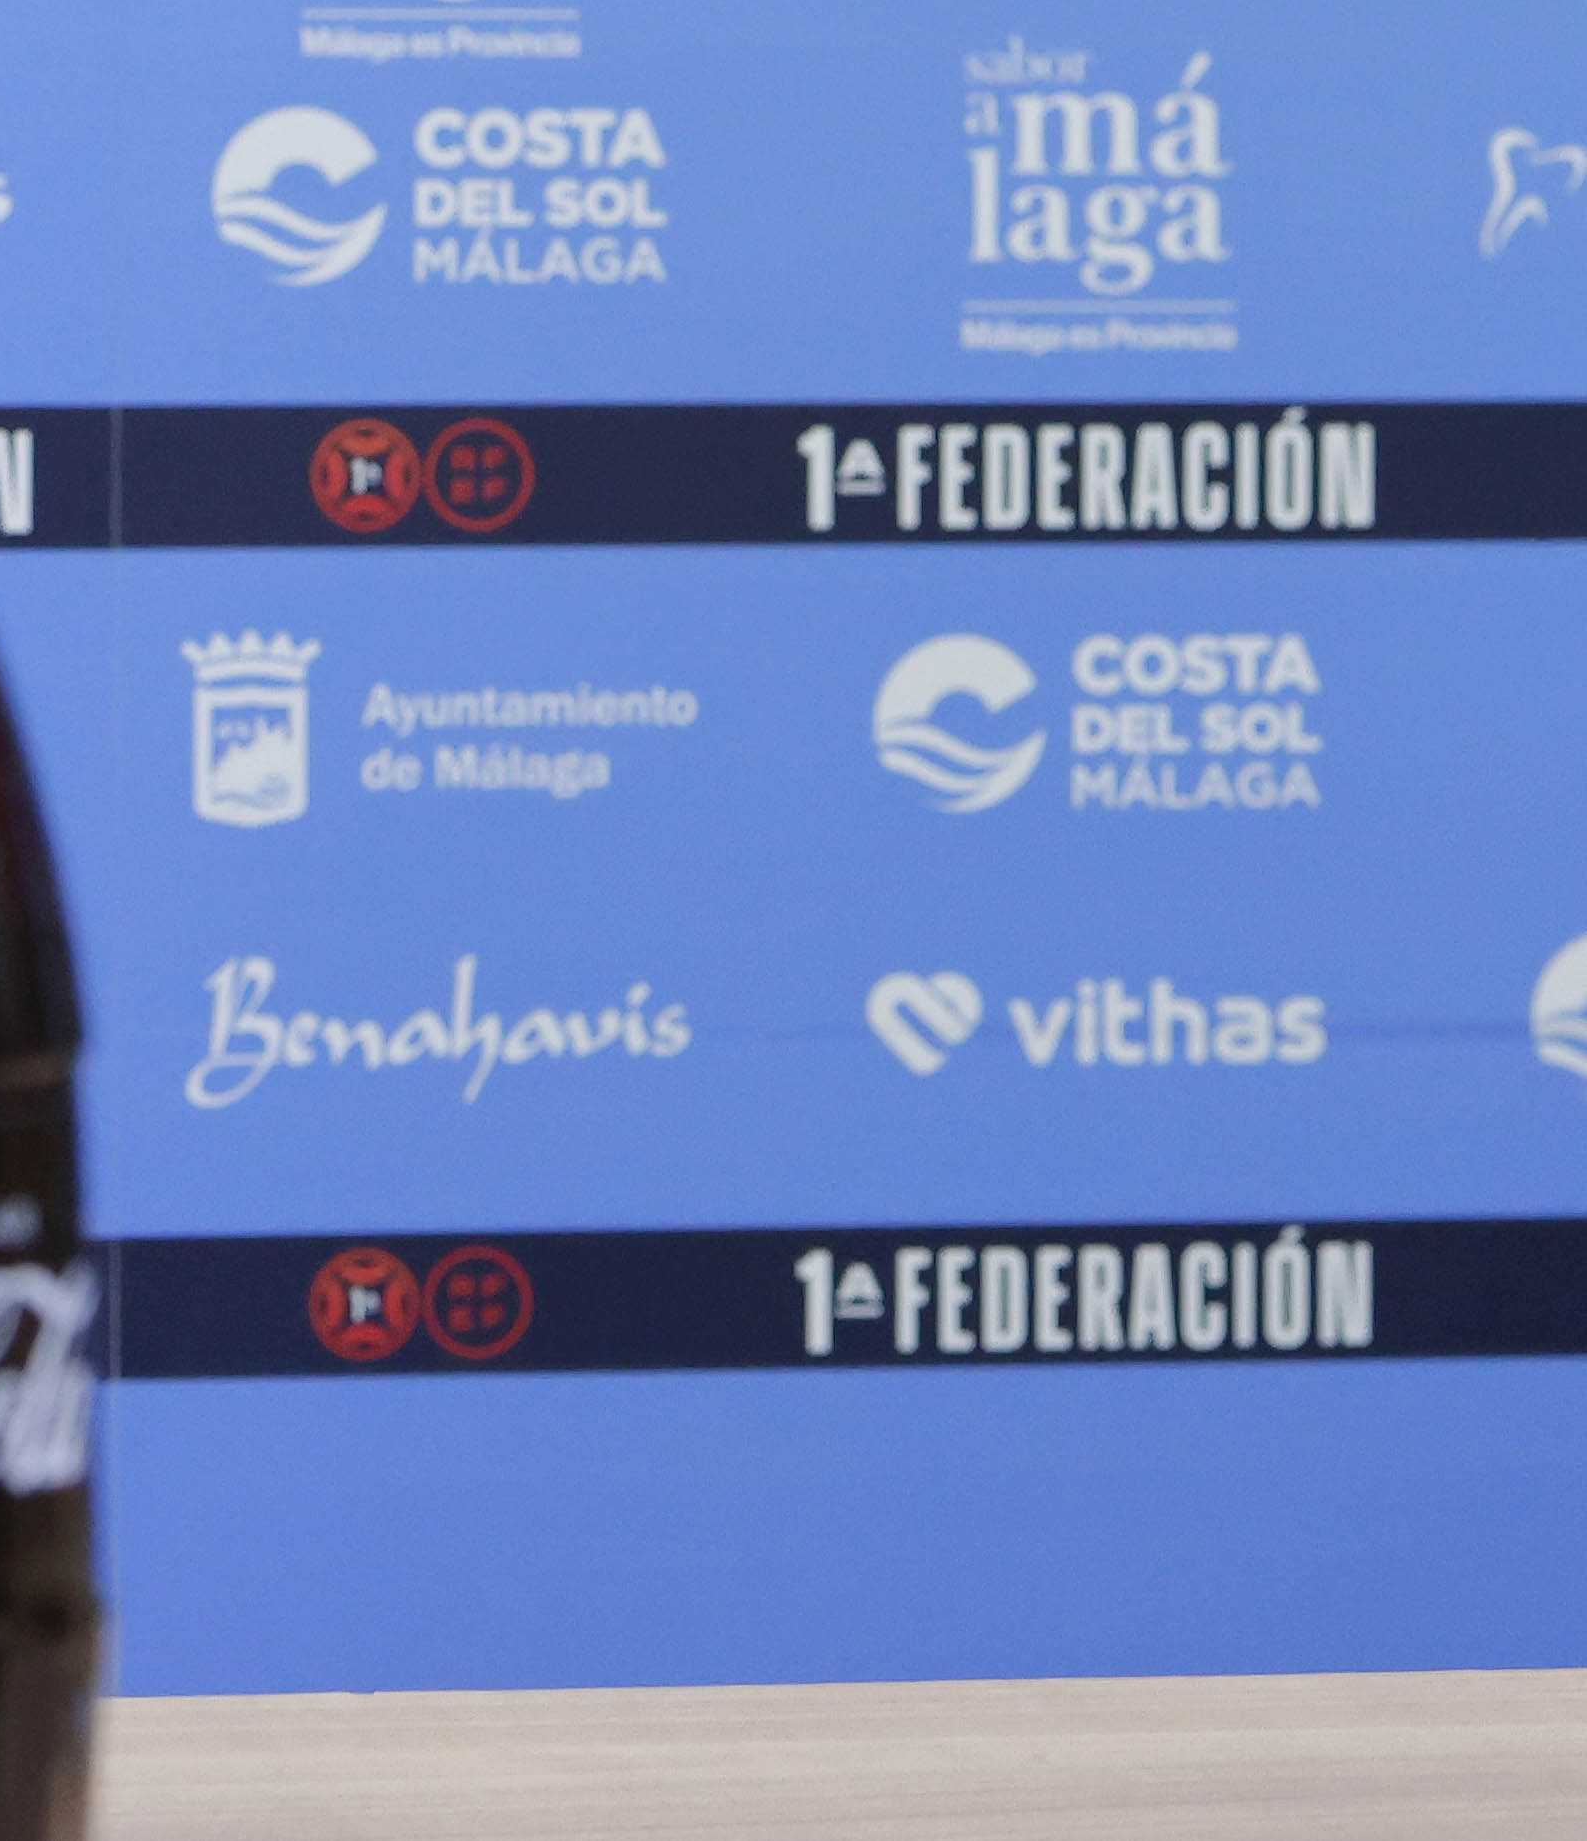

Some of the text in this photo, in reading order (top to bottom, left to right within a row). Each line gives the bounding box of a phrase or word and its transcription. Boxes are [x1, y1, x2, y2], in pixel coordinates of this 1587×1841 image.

[414, 108, 665, 168] COSTA
[1013, 52, 1227, 177] má
[414, 178, 667, 232] DEL SOL
[413, 219, 665, 283] MÁLAGA
[898, 407, 1374, 530] FEDERACIÓN
[1073, 634, 1319, 695] COSTA
[362, 683, 698, 737] Ayuntamiento
[1072, 703, 1322, 757] DEL SOL
[360, 744, 610, 799] de Málaga
[1070, 749, 1320, 810] MÁLAGA
[1009, 978, 1325, 1065] vithas
[896, 1225, 1372, 1352] FEDERACIÓN
